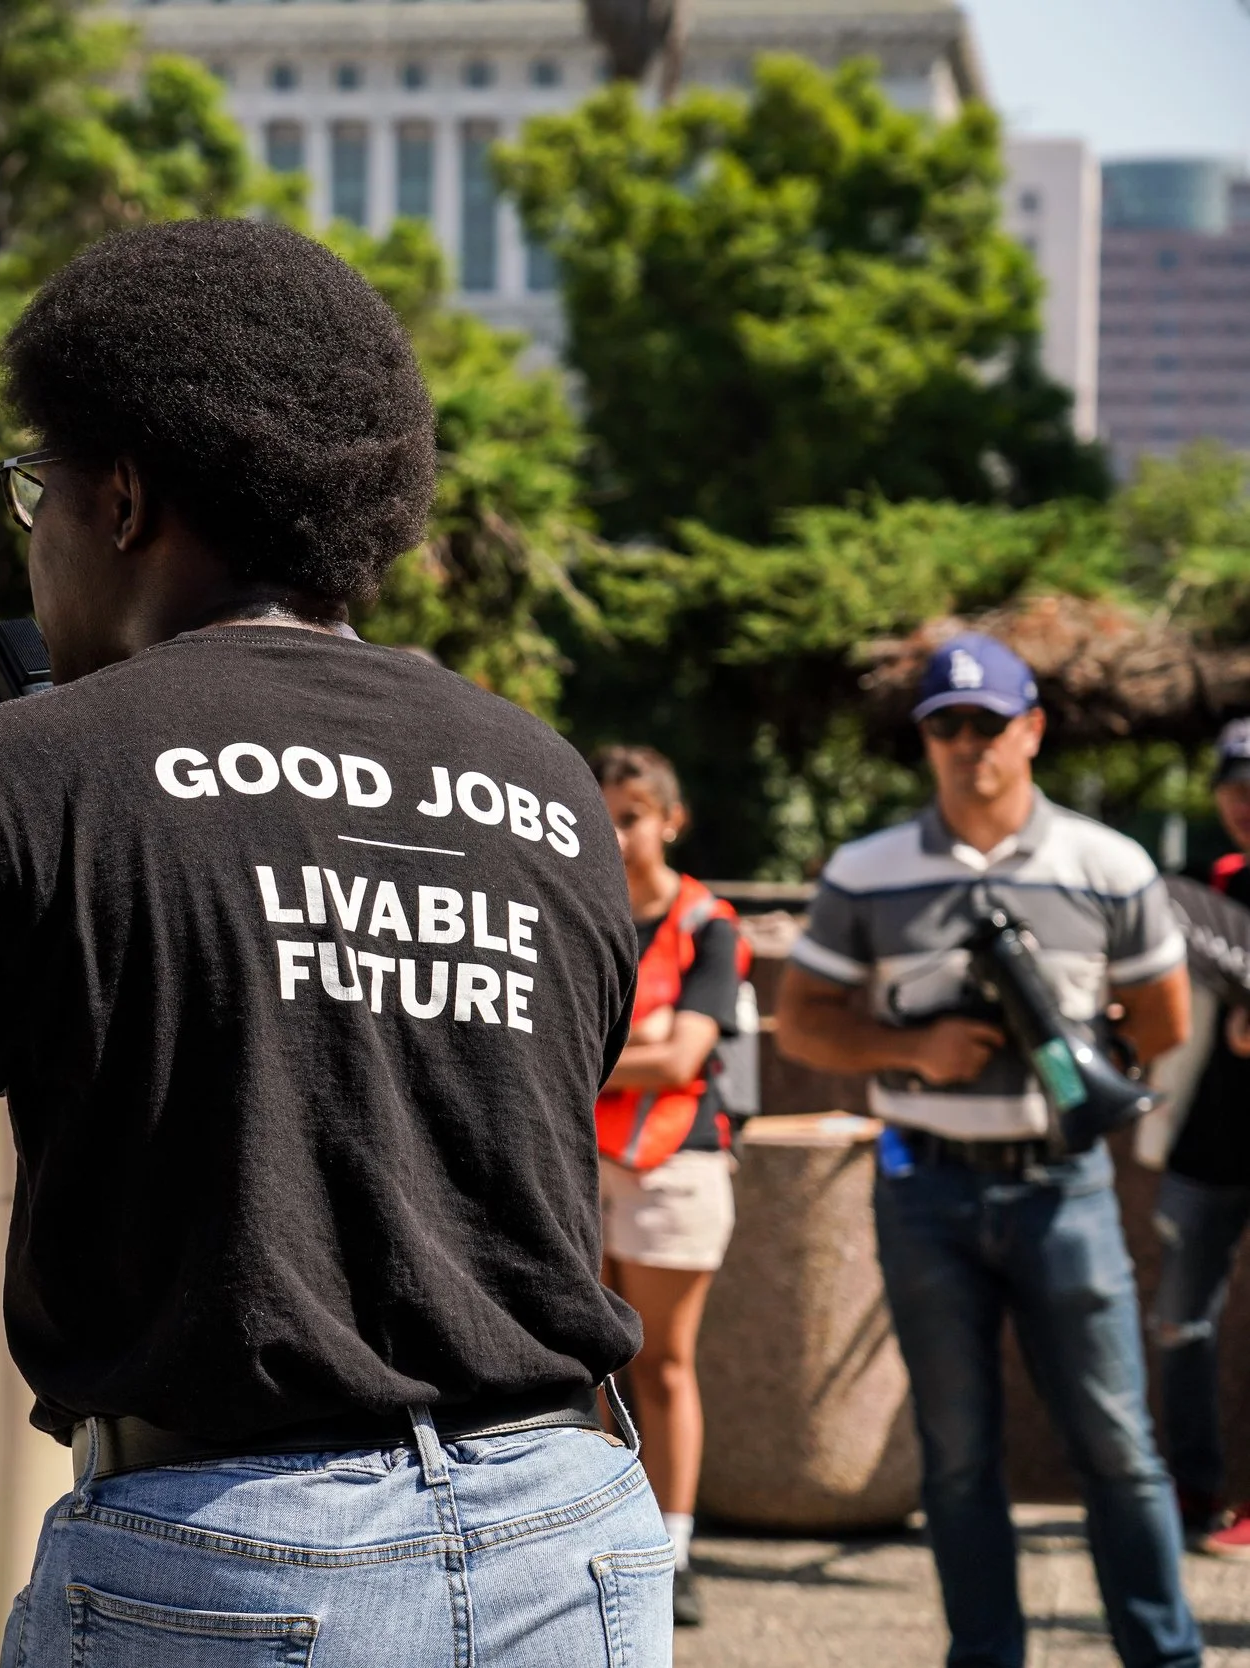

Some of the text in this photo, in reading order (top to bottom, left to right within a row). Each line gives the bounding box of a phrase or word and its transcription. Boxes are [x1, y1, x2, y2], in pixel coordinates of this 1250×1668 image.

[154, 742, 580, 858] GOOD JOBS
[255, 865, 539, 963] LIVABLE
[276, 939, 534, 1034] FUTURE
